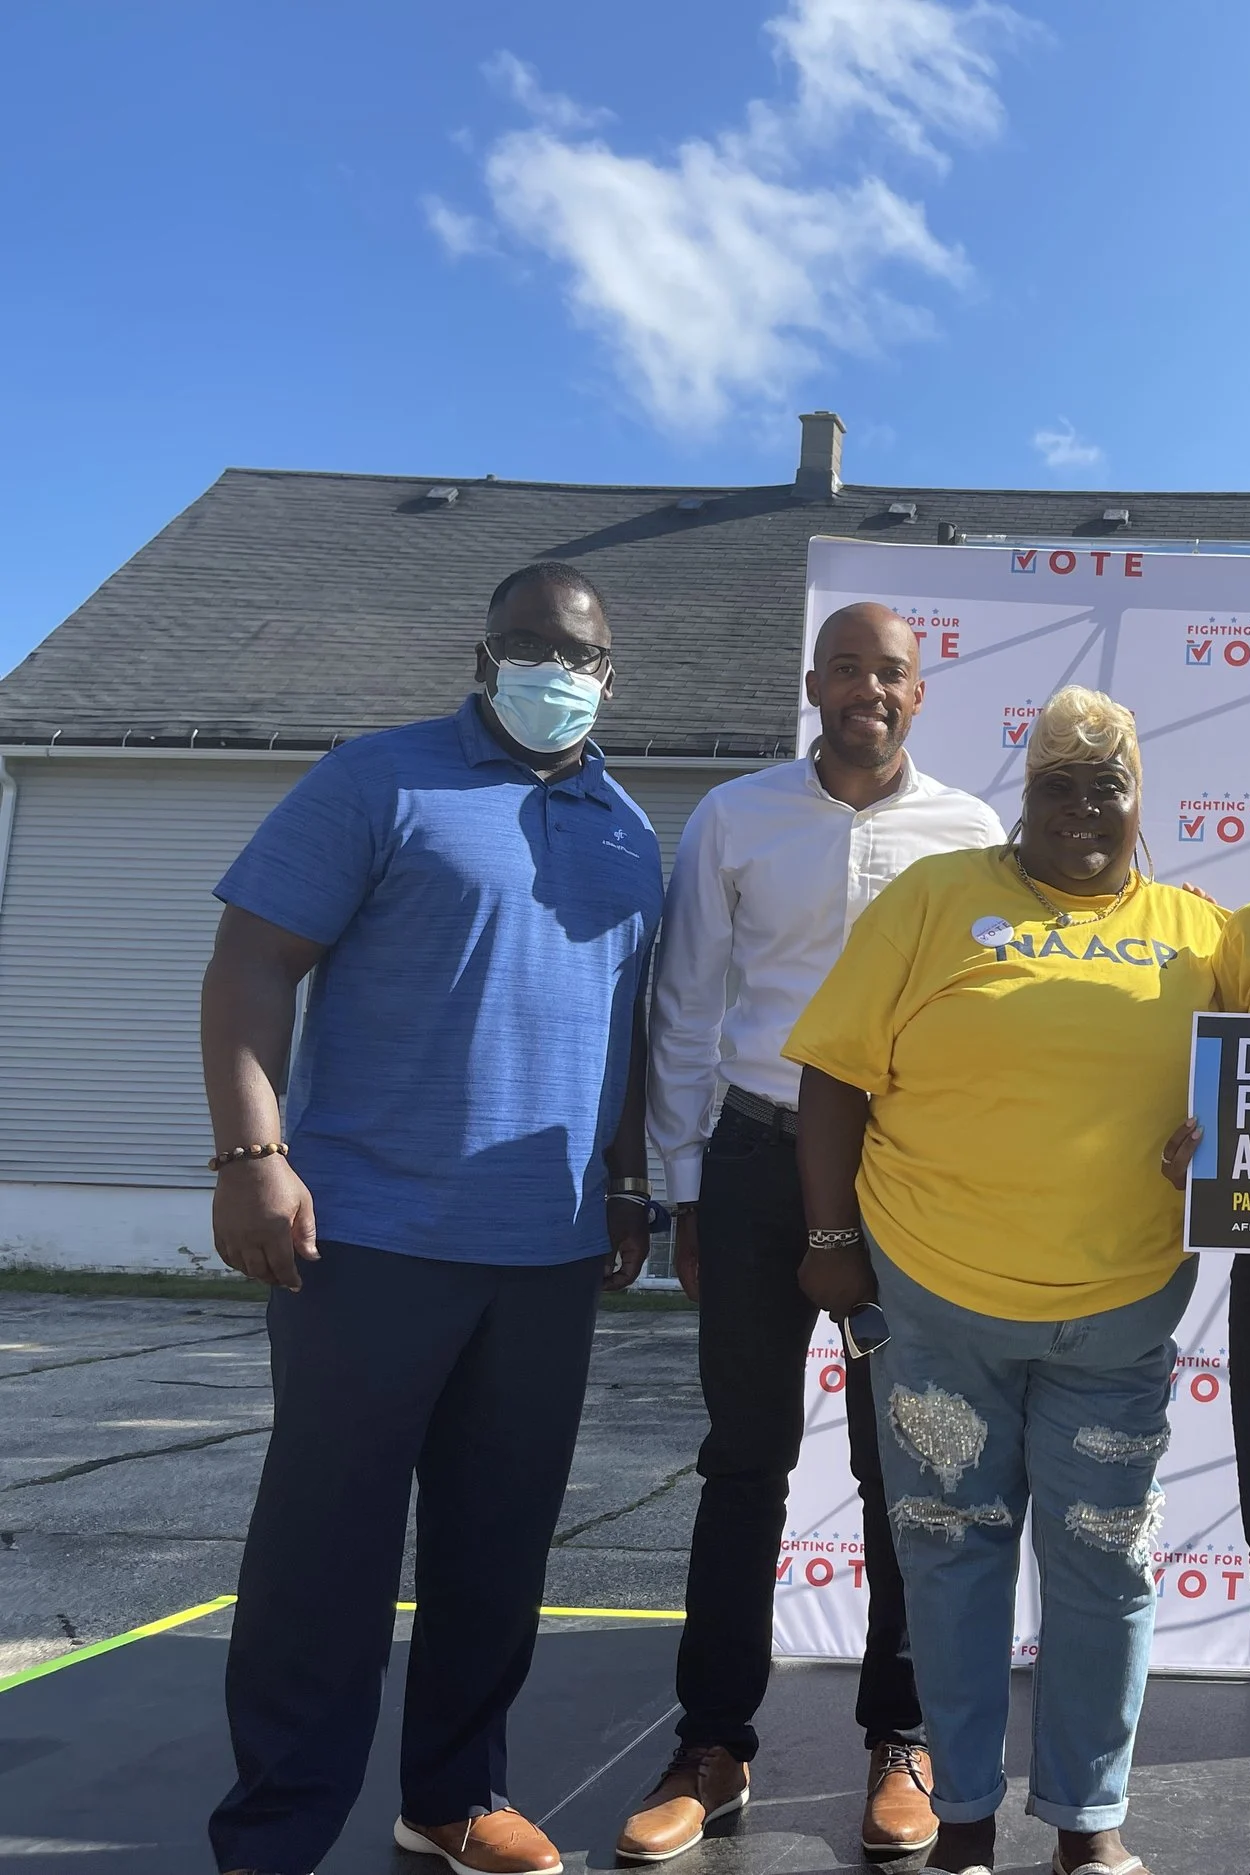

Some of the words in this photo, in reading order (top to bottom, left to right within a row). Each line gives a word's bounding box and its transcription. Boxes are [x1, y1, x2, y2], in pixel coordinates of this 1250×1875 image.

[1011, 550, 1143, 577] VOTE
[902, 617, 925, 626] OR
[931, 617, 959, 627] OUR
[1187, 625, 1250, 636] FIGHTING
[1004, 707, 1043, 717] FIGHT
[1180, 801, 1245, 811] FIGHTING
[995, 930, 1178, 969] NAACP
[1177, 1357, 1220, 1368] HTING
[781, 1541, 834, 1552] GHTING
[1153, 1552, 1208, 1564] GHTING
[1215, 1555, 1242, 1565] FOR
[1021, 1645, 1038, 1656] FO
